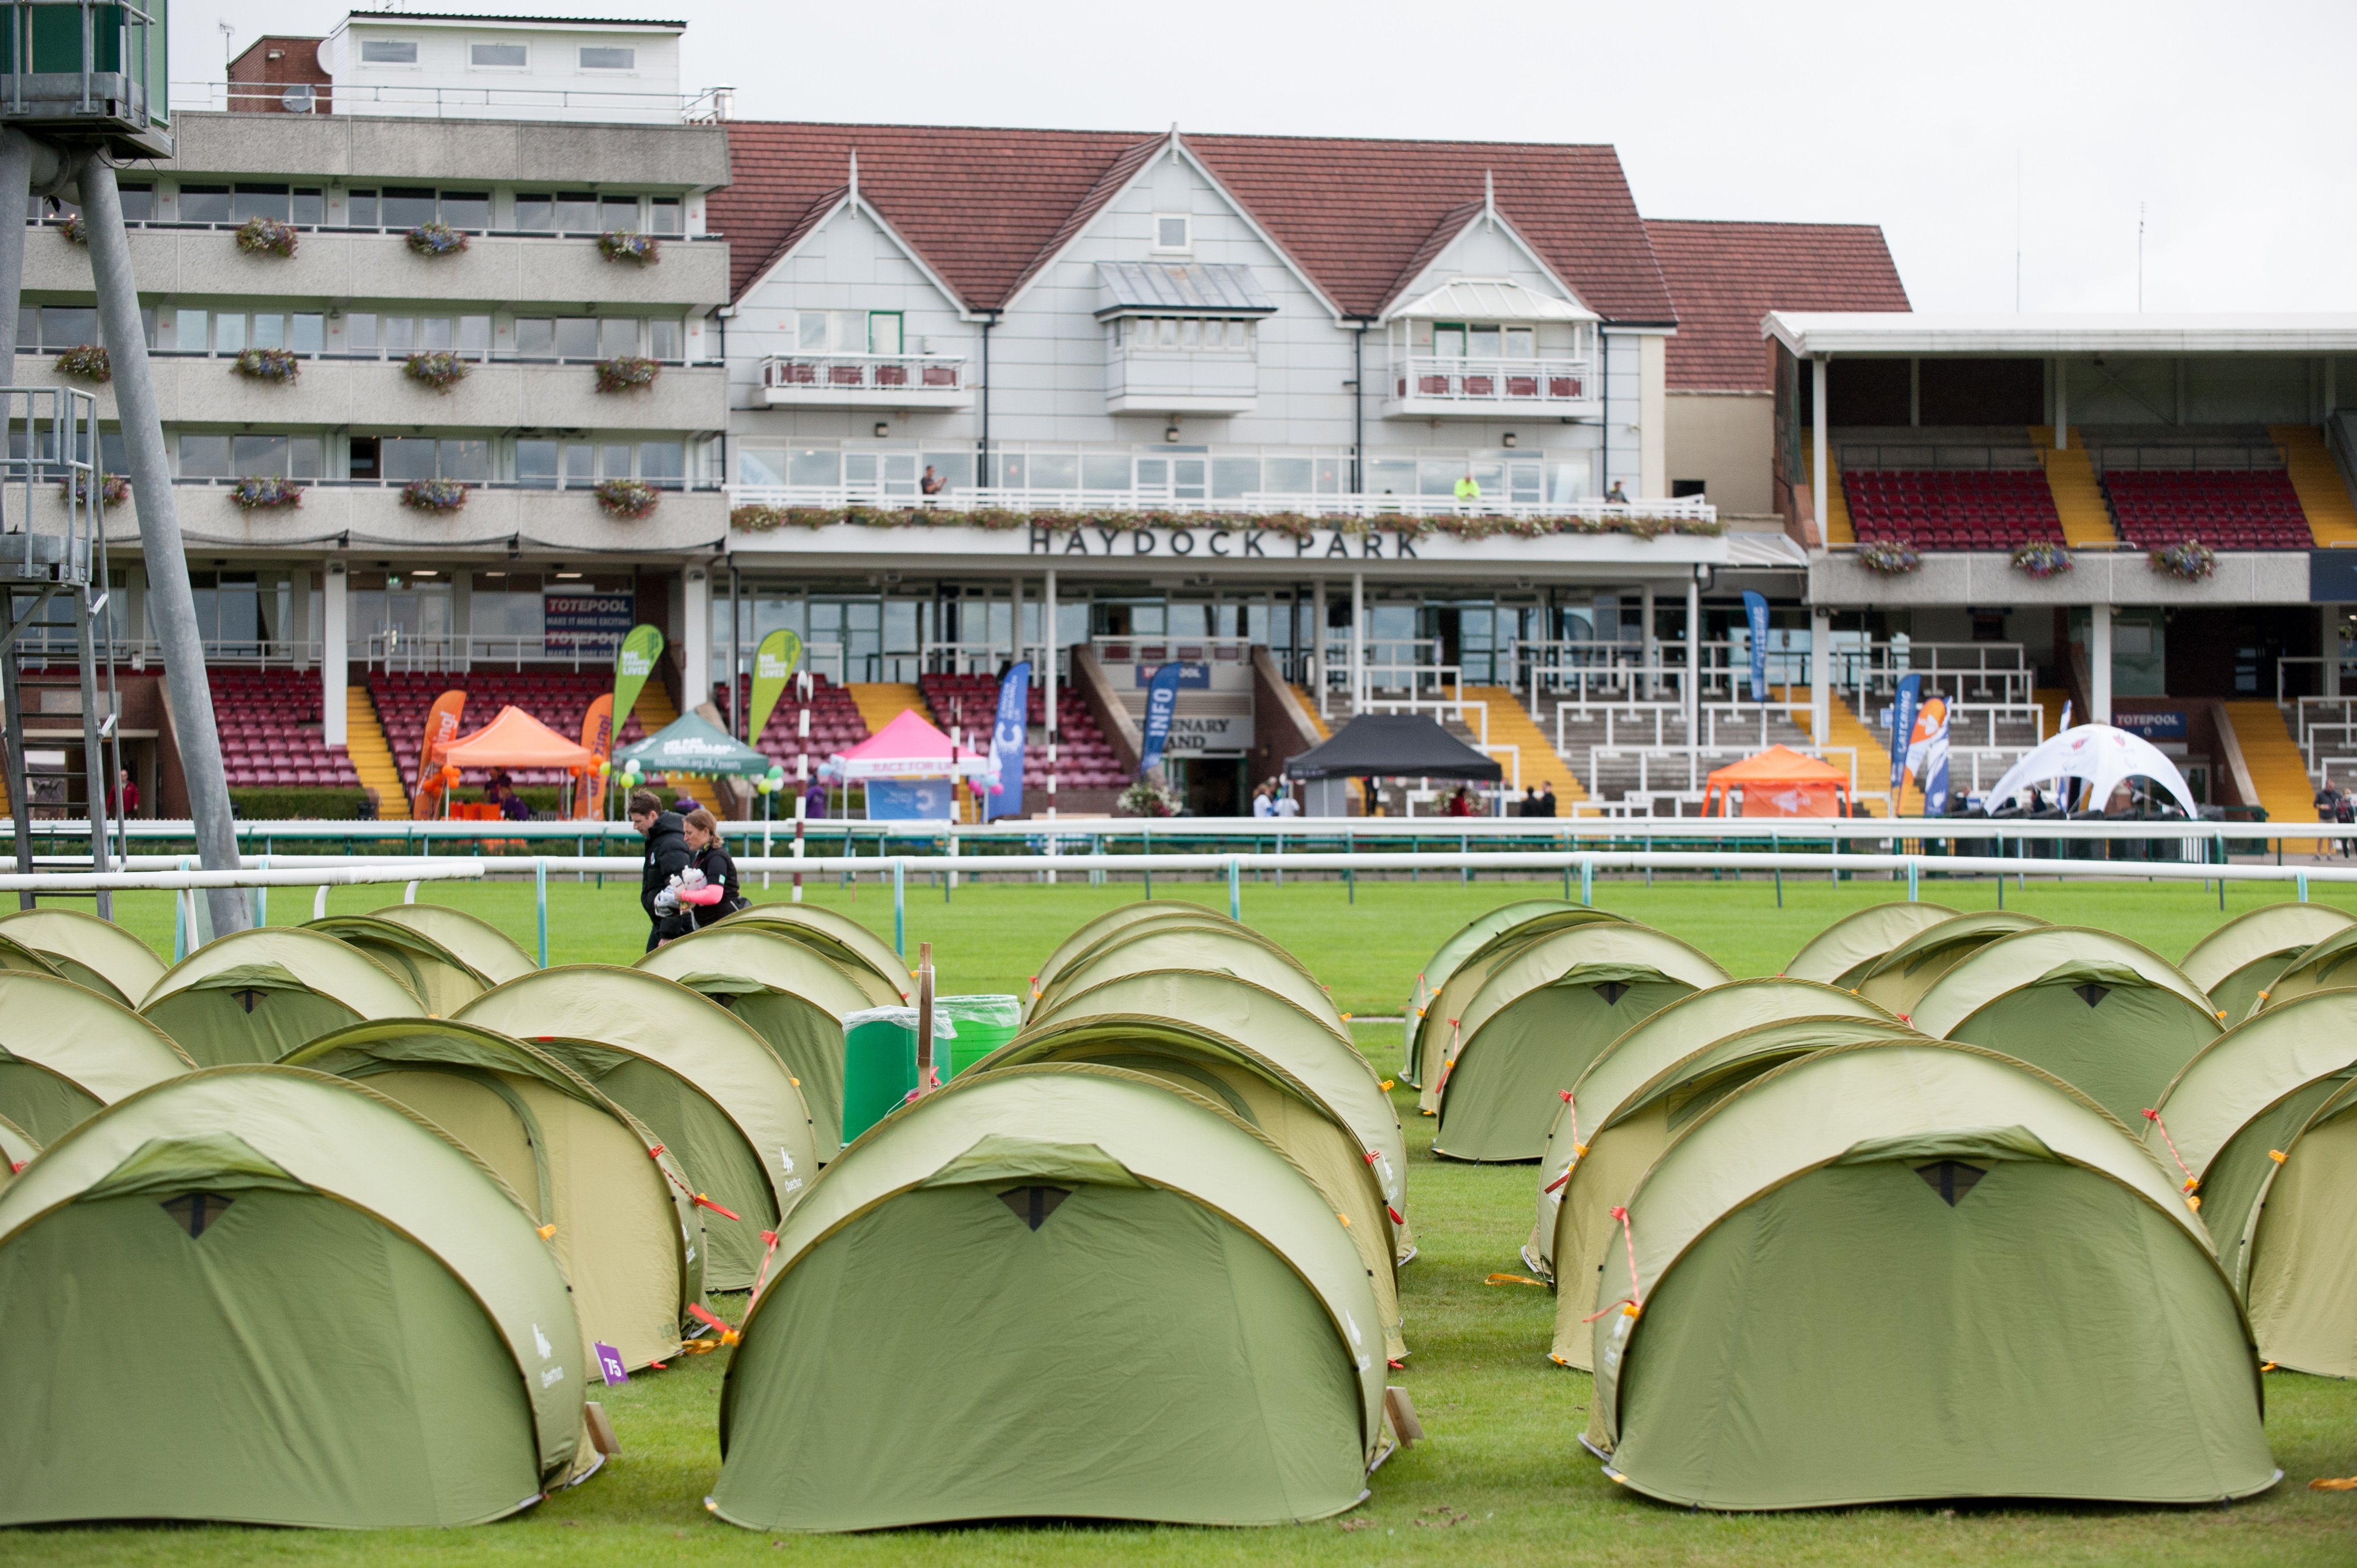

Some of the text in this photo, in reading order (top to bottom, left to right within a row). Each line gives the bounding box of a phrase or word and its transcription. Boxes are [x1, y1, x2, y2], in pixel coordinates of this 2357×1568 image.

[1030, 526, 1417, 558] HAYDOCK PARK
[549, 599, 629, 612] TOTEPOOL
[1149, 688, 1173, 737] INFO
[2116, 714, 2178, 726] TOTEPOOL
[604, 1357, 622, 1377] 75
